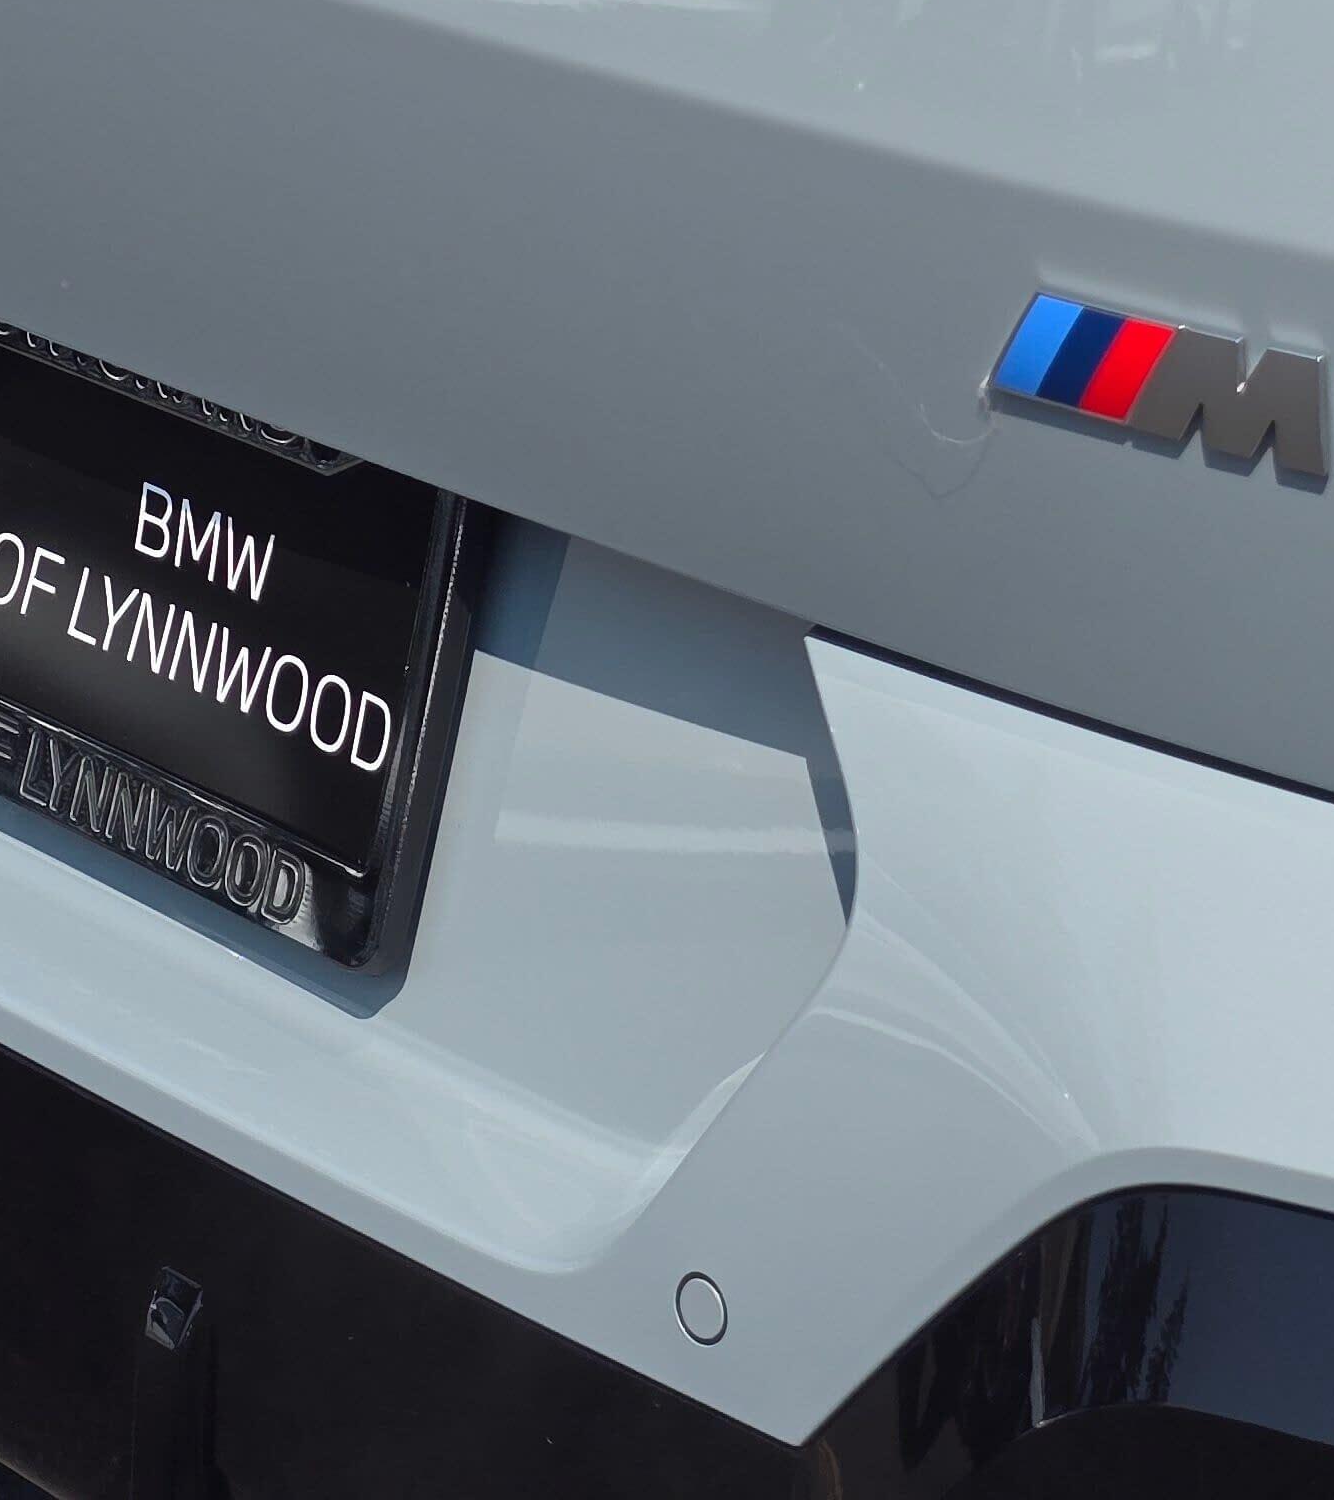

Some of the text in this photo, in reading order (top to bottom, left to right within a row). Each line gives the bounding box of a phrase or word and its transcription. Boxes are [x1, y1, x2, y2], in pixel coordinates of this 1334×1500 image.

[135, 481, 275, 602] BMW
[67, 566, 391, 772] LYNNWOOD
[19, 727, 306, 925] LYNNWOOD
